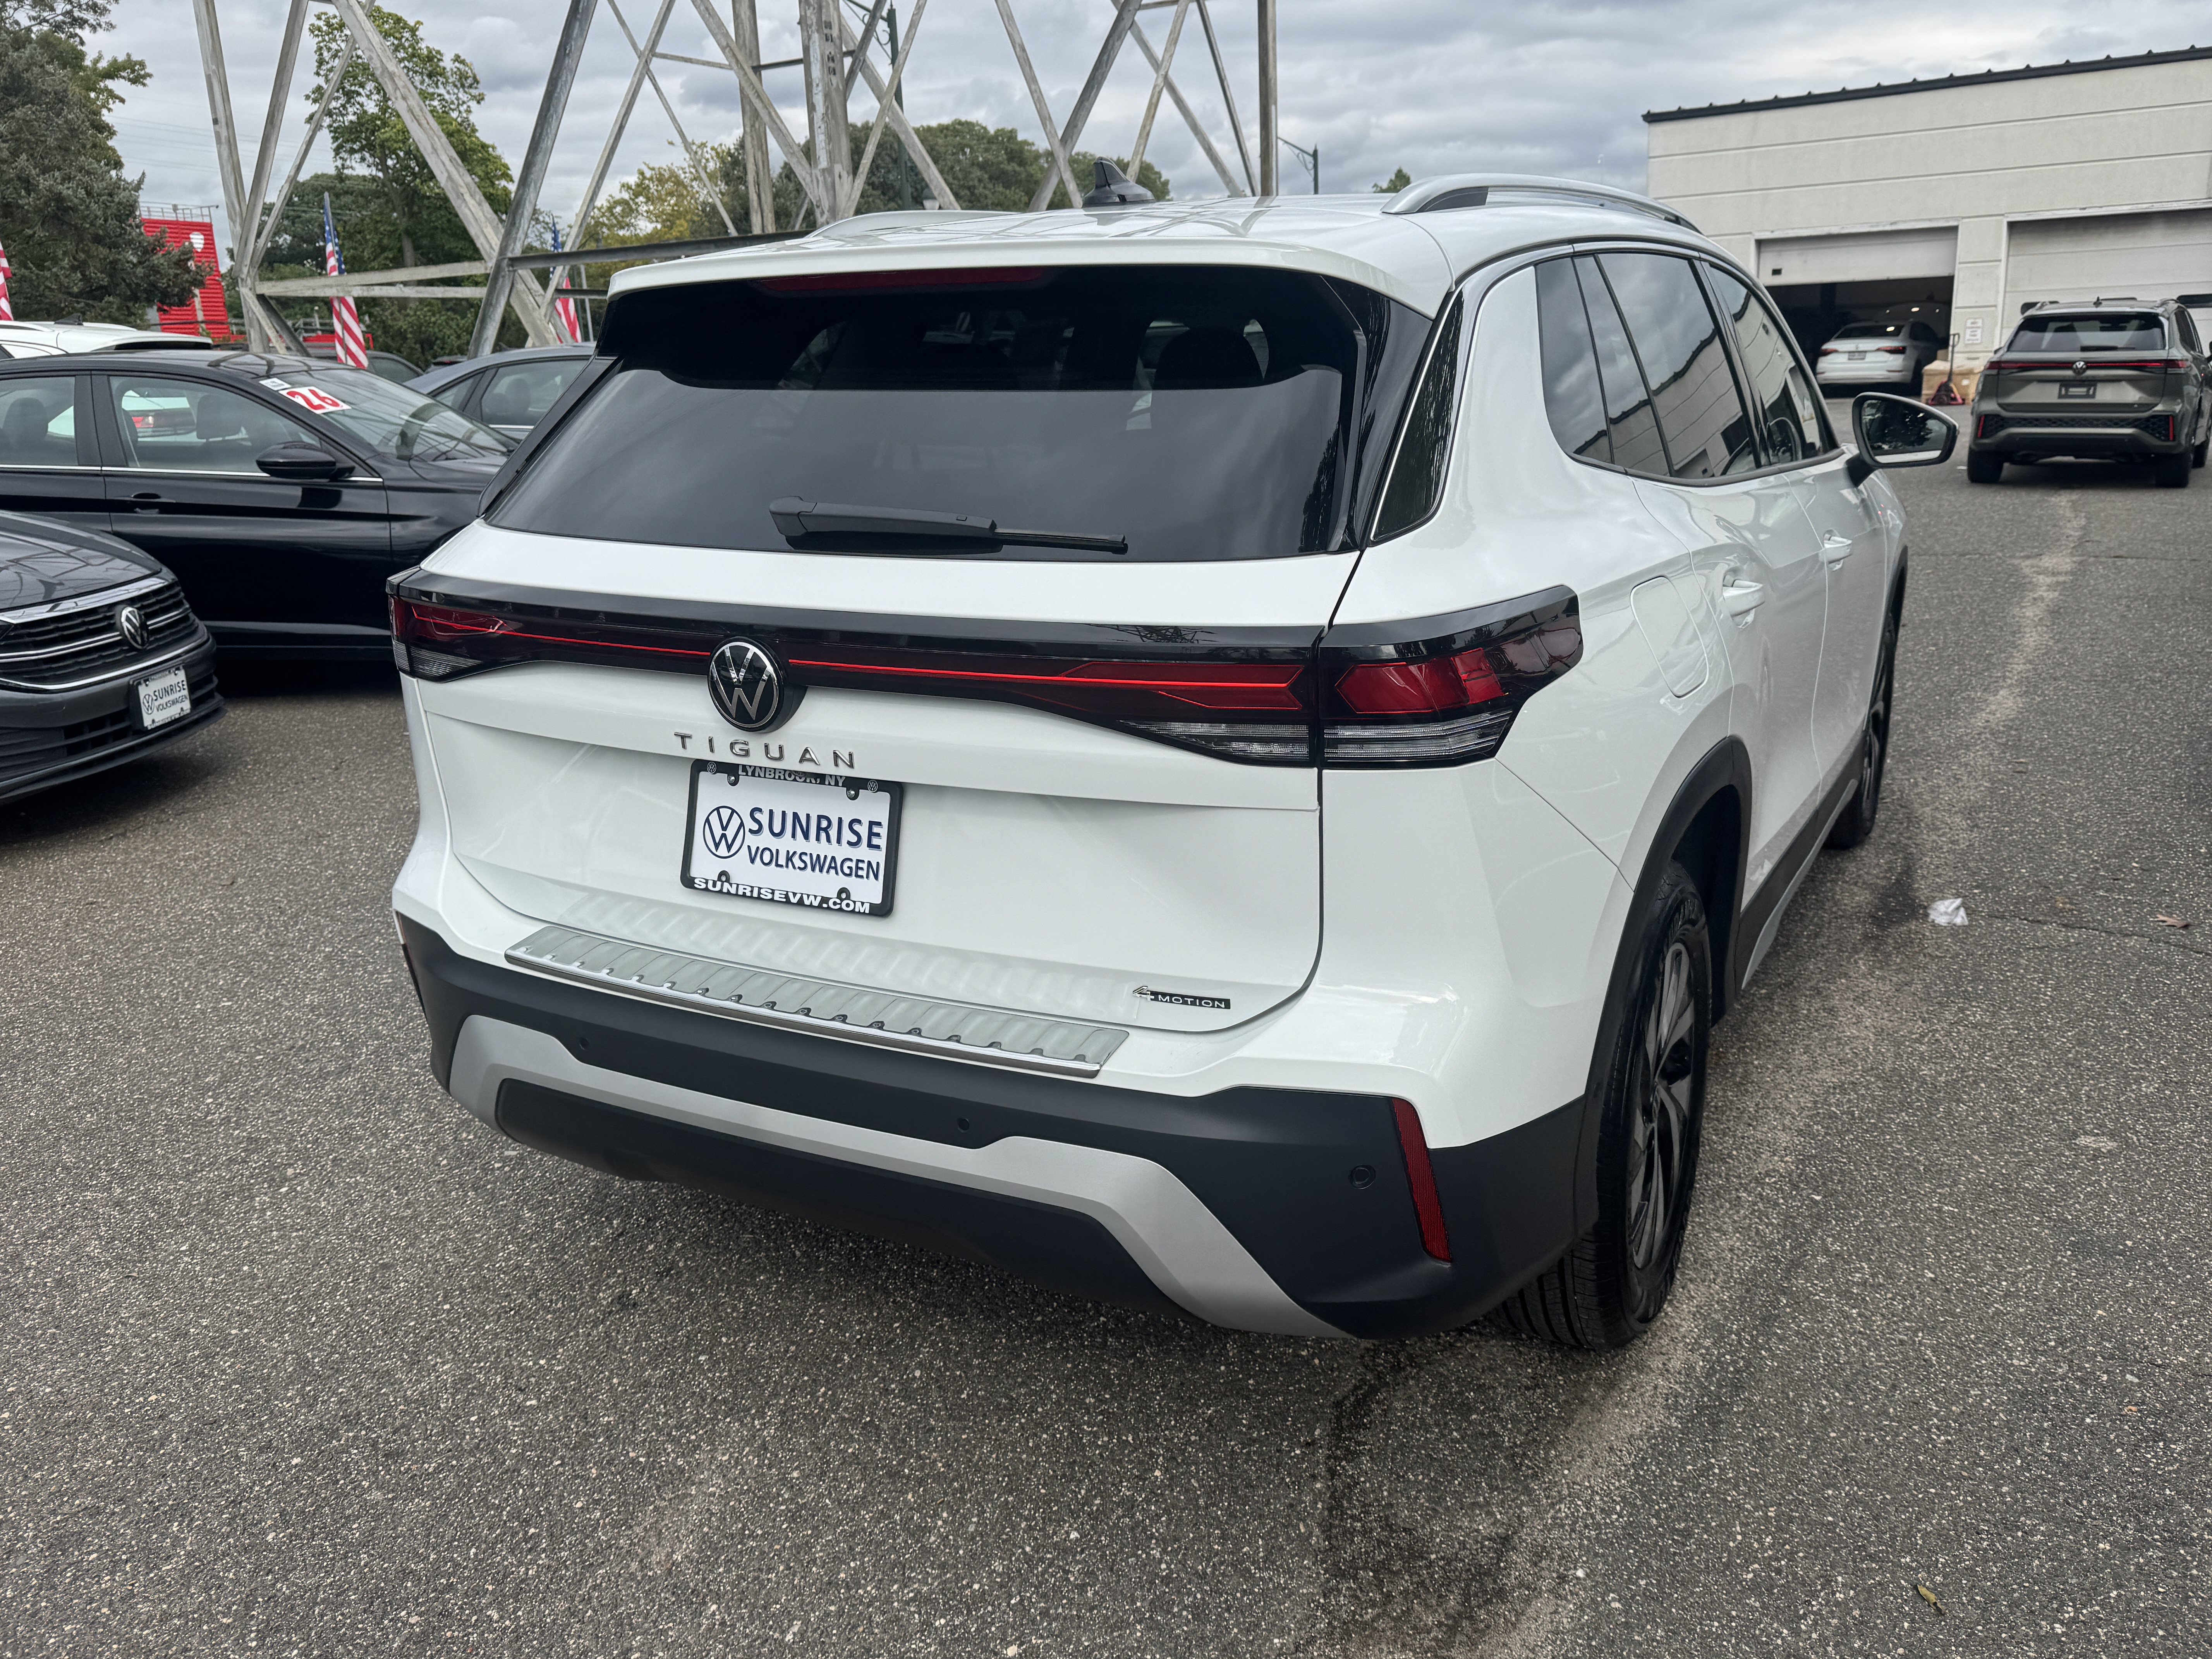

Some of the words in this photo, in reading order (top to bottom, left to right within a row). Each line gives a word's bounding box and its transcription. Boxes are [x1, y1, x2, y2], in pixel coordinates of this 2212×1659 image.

[287, 389, 340, 410] 26
[153, 680, 186, 701] SUNRISE
[709, 641, 779, 728] VW
[156, 694, 188, 712] VOLKSWAGEN
[674, 732, 855, 769] TIGUAN
[825, 775, 846, 787] NY
[703, 805, 745, 859] VW
[749, 807, 883, 851] SUNRISE
[747, 845, 880, 881] VOLKSWAGEN
[694, 878, 870, 914] SUNRISEVW.COM
